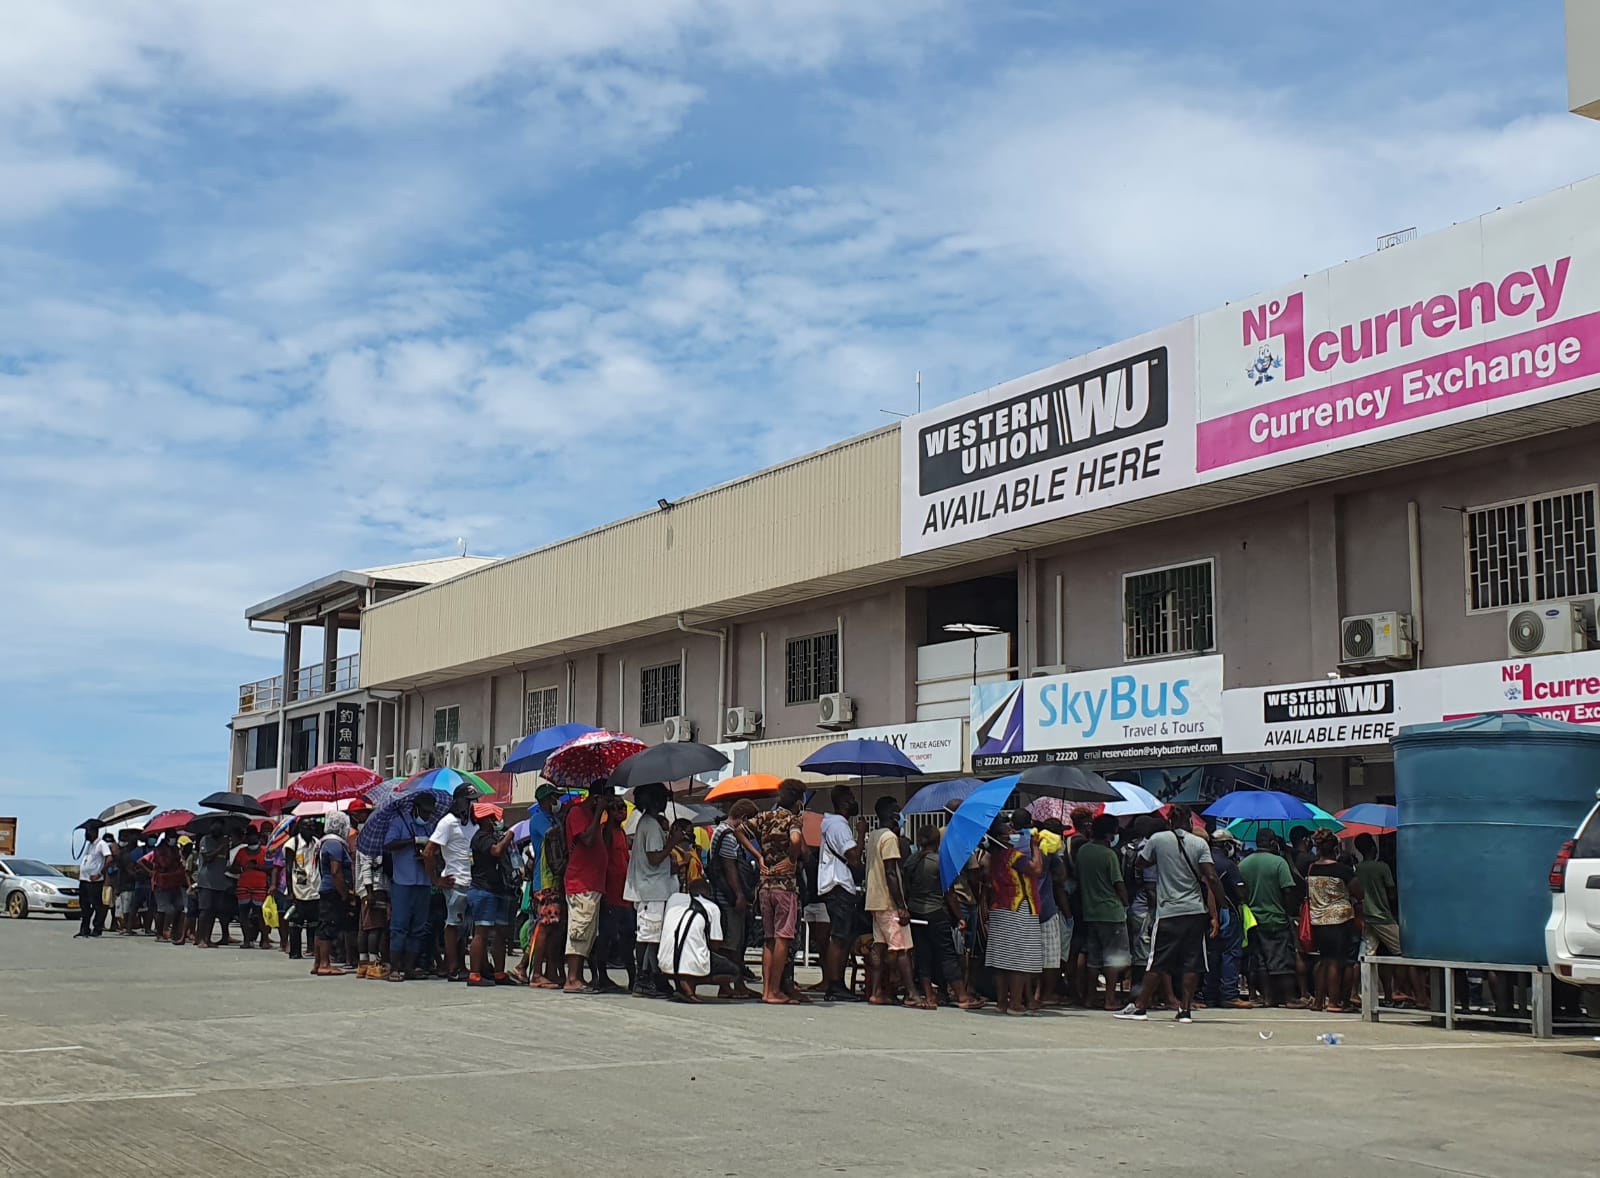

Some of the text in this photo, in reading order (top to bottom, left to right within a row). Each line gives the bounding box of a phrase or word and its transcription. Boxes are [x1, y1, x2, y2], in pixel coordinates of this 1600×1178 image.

[1308, 256, 1571, 372] currency
[1064, 359, 1149, 442] WU
[1249, 336, 1582, 443] Currency Exchange
[925, 394, 1049, 457] WESTERN
[961, 424, 1049, 475] UNION
[922, 440, 1164, 535] AVAILABLE HERE
[1038, 675, 1190, 738] SkyBus
[1267, 688, 1336, 706] WESTERN
[1288, 702, 1336, 717] UNION
[1343, 683, 1386, 712] WU
[909, 741, 927, 749] TRADE
[928, 739, 951, 748] AGENCY
[1123, 721, 1204, 738] Travel & Tours
[1264, 722, 1395, 746] AVAILABLE HERE
[1056, 751, 1078, 760] 22220
[1084, 750, 1101, 760] email
[1102, 744, 1217, 758] reservation@skybustravel.com
